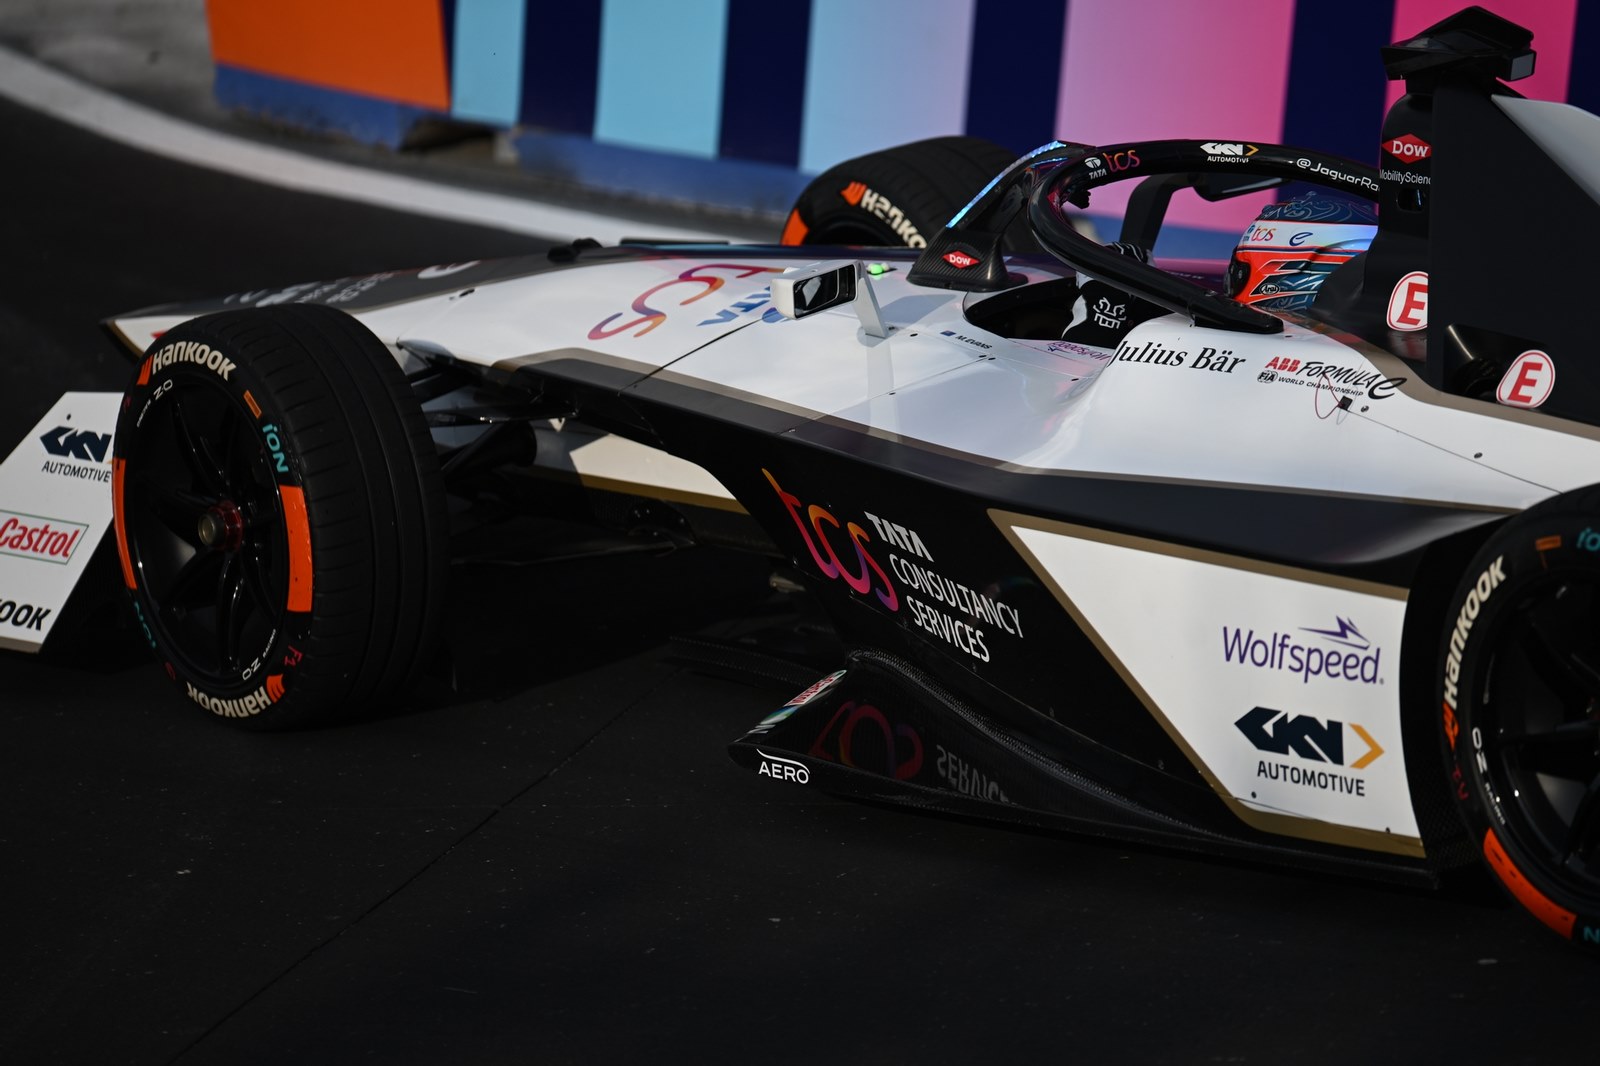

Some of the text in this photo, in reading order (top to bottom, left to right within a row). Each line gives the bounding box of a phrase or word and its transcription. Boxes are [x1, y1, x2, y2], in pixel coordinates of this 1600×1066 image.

[1103, 149, 1141, 173] tcs
[1207, 155, 1249, 163] AUTOMOTIVE
[1391, 140, 1429, 157] DOW
[1088, 168, 1107, 180] TATA
[1296, 157, 1380, 192] @JaguarRa
[949, 254, 972, 266] DOW
[1396, 282, 1429, 326] E
[1107, 340, 1246, 374] Julius Bär
[1265, 356, 1301, 373] ABB
[1258, 371, 1364, 397] FIA WORLD CHAMPIONSHIP
[1507, 361, 1543, 404] E
[41, 460, 112, 483] AUTOMOTIVE
[0, 518, 80, 558] Castrol
[761, 468, 899, 612] tcs
[864, 511, 934, 562] TATA
[889, 553, 1024, 639] CONSULTANCY
[906, 595, 990, 663] SERVICES
[1223, 625, 1381, 684] Wolfspeed
[758, 761, 809, 784] AERO
[1257, 760, 1366, 797] AUTOMOTIVE
